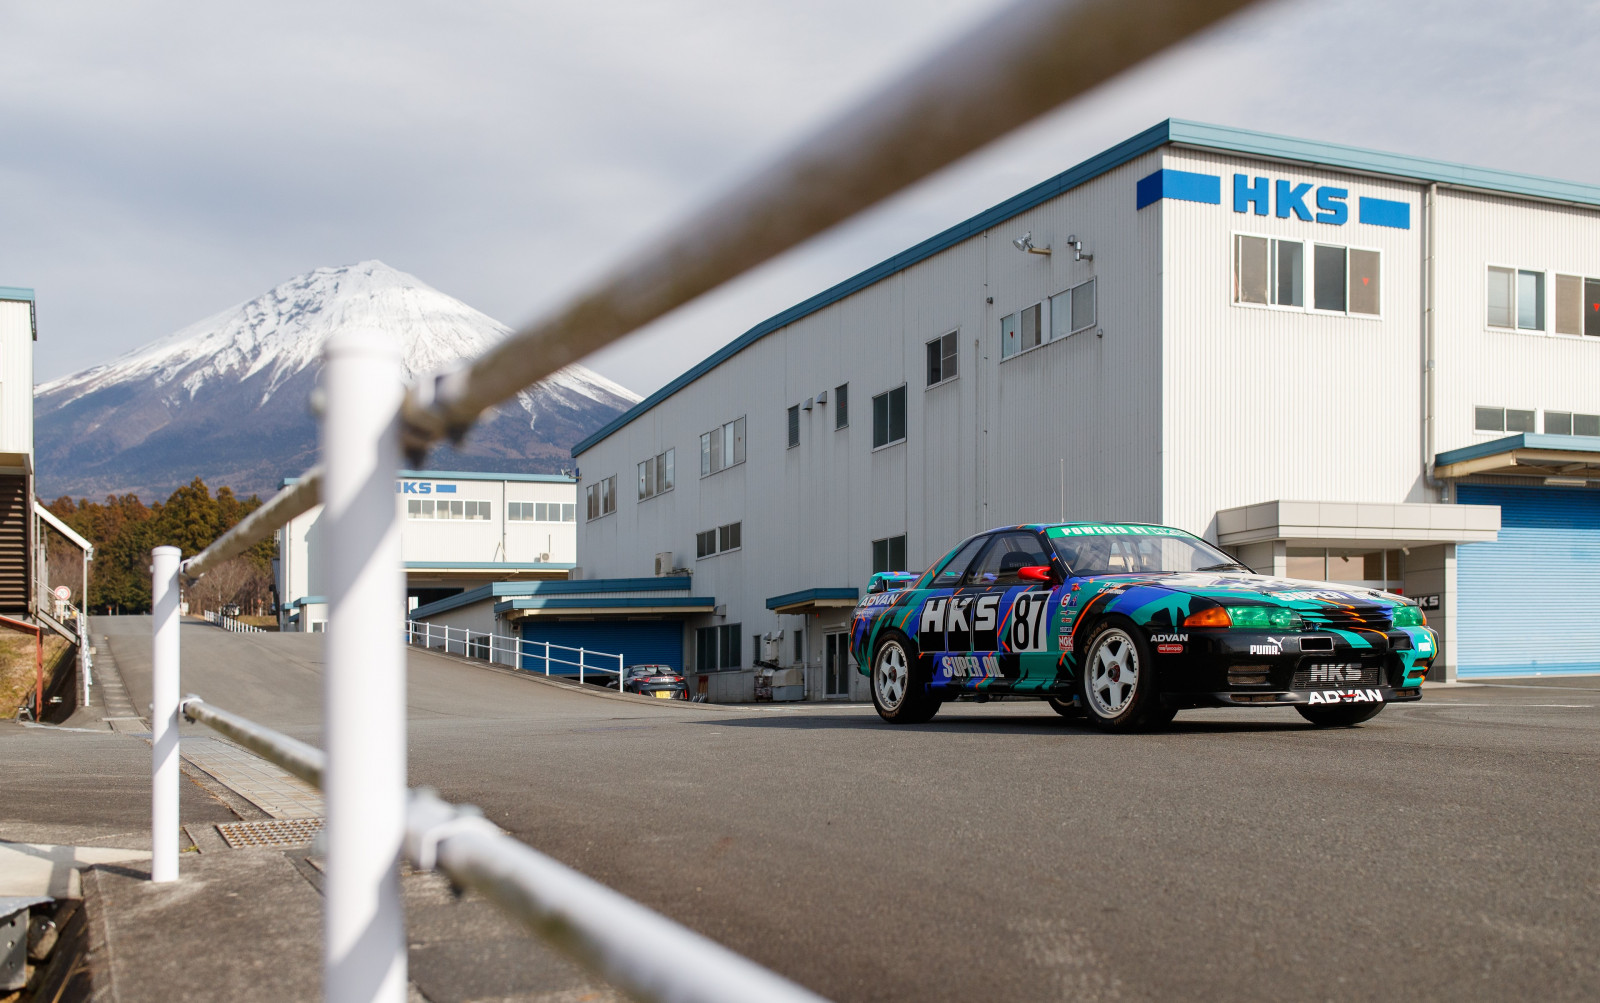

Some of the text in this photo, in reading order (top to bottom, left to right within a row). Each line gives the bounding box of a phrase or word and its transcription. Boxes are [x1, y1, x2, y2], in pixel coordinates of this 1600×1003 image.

[1233, 173, 1349, 226] HKS
[1061, 526, 1128, 536] POWERED
[859, 593, 899, 607] ADVAN
[921, 595, 1000, 632] HKS
[1013, 593, 1049, 650] 87
[1059, 635, 1073, 647] NGK
[1150, 634, 1189, 642] ADVAN
[942, 656, 1004, 678] SUPER OIL
[1310, 664, 1362, 682] HKS
[1308, 689, 1383, 705] ADVAN
